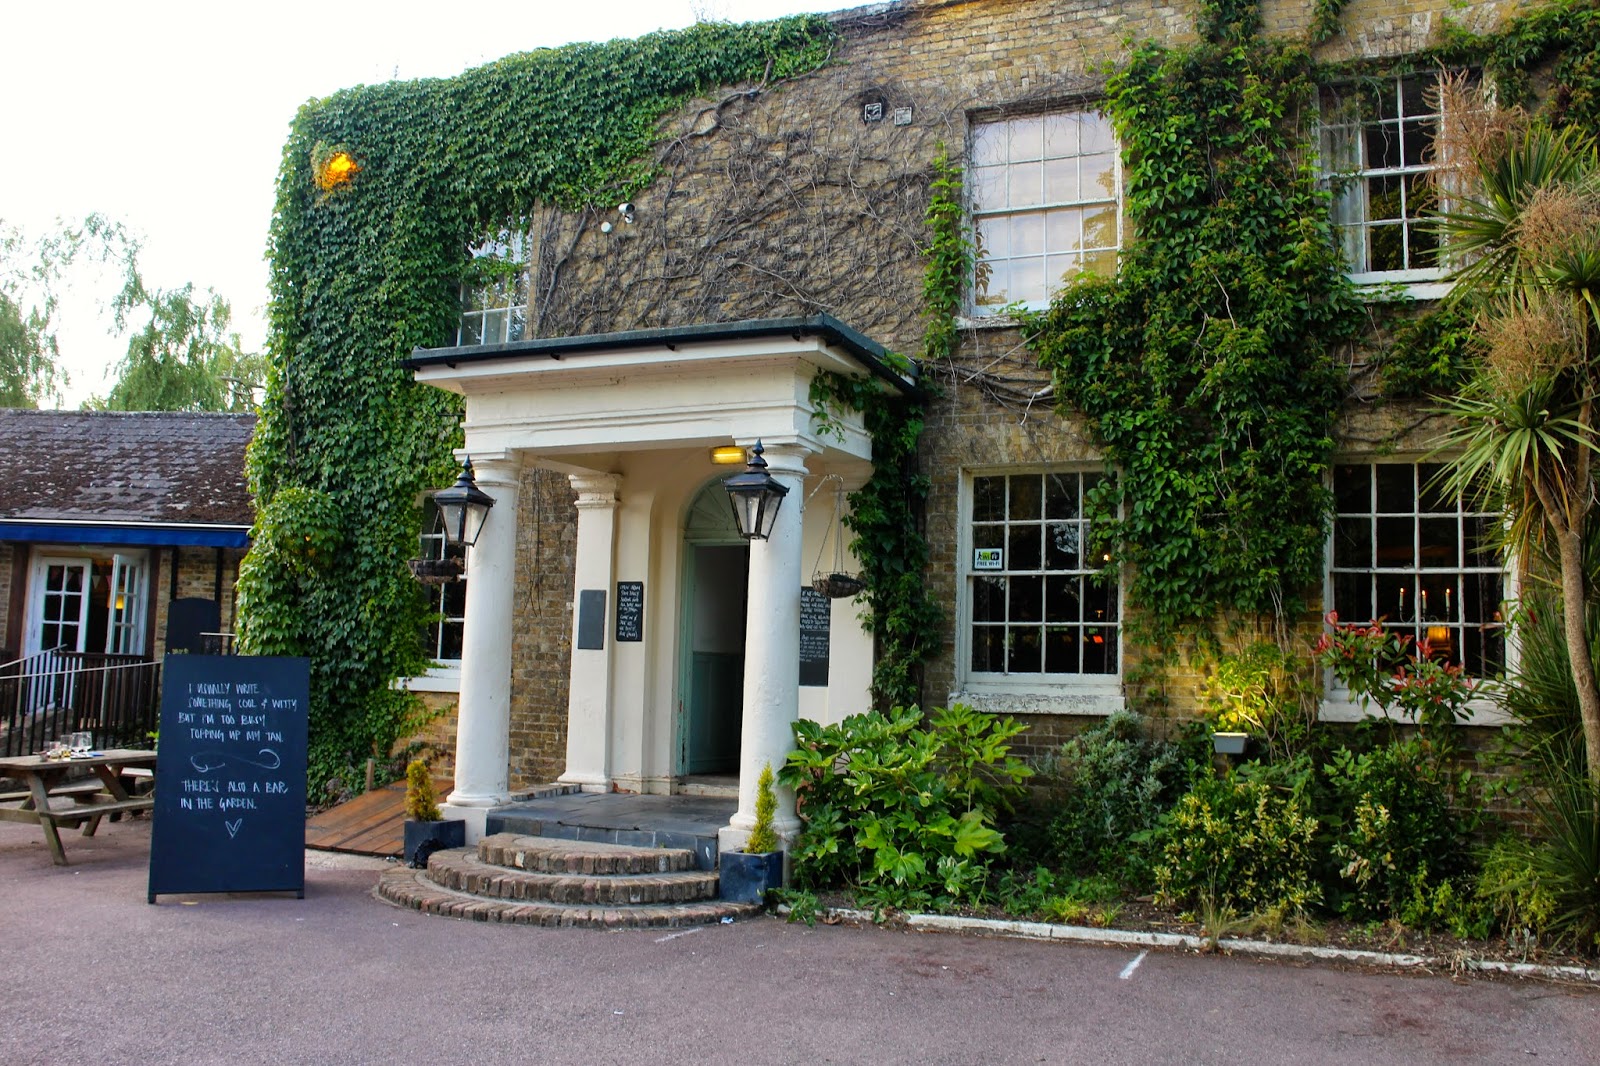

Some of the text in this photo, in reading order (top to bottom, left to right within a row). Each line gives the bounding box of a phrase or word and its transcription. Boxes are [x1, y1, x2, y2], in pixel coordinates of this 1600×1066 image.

[188, 683, 260, 694] I USUALLY WRITE
[188, 698, 232, 712] SOMETHING
[238, 698, 257, 708] COOL
[271, 699, 297, 711] WITTY
[178, 712, 196, 724] BUT
[221, 714, 235, 725] TOO
[241, 714, 266, 727] BUSY
[190, 728, 224, 742] TOPPING
[229, 731, 241, 741] UP
[246, 730, 261, 742] MY
[181, 780, 219, 793] THERE'S
[227, 781, 246, 793] ALSO
[253, 782, 261, 794] A
[180, 797, 193, 810] IN
[196, 797, 213, 809] THE
